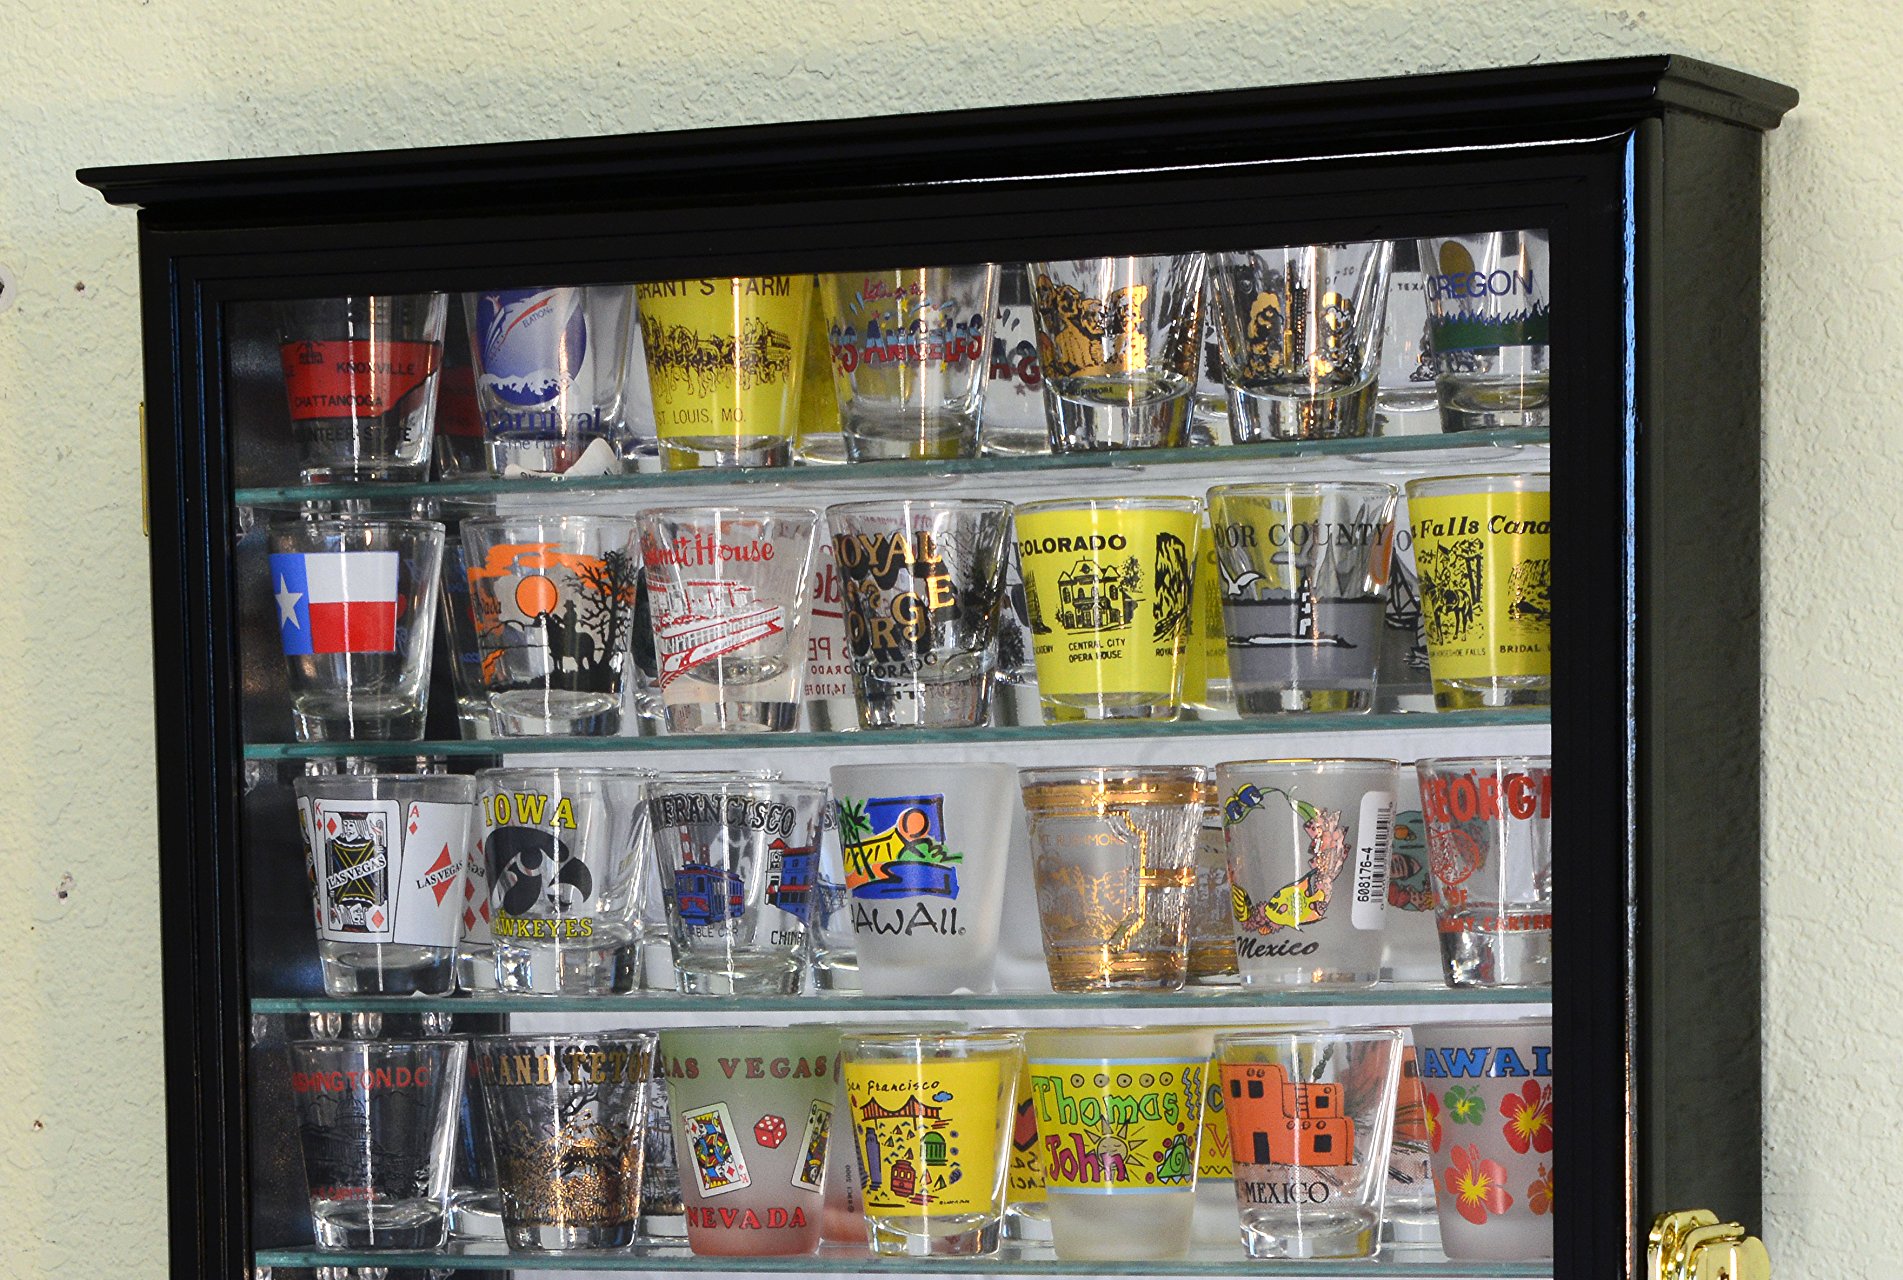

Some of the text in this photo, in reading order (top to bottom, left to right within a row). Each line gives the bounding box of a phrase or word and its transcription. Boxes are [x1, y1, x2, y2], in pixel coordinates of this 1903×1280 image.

[731, 277, 790, 298] FARM
[1428, 270, 1531, 300] OREGON
[336, 360, 415, 376] KNOXVILLE
[673, 408, 714, 425] LOUIS,
[721, 407, 747, 422] MO.
[1269, 520, 1387, 547] COUNTY
[1420, 516, 1479, 538] Falls
[695, 533, 775, 566] House
[1021, 534, 1127, 558] COLORADO
[1069, 638, 1126, 652] CENTRAL CITY
[1500, 645, 1540, 654] BRIDAL
[1069, 654, 1098, 664] OPERA
[410, 805, 420, 818] A
[483, 793, 577, 830] IOWA
[663, 792, 797, 838] FRANCISCO
[327, 856, 386, 889] LAS VEGAS
[416, 875, 437, 889] LAS
[438, 861, 463, 882] VEGAS
[1357, 847, 1373, 903] 608176-4
[1236, 936, 1319, 959] Mexico
[718, 1055, 827, 1080] VEGAS
[867, 1079, 940, 1095] Francisco
[1032, 1075, 1180, 1127] Thomas
[1045, 1132, 1127, 1183] John
[1245, 1181, 1330, 1205] MEXICO
[688, 1206, 807, 1229] NEVADA
